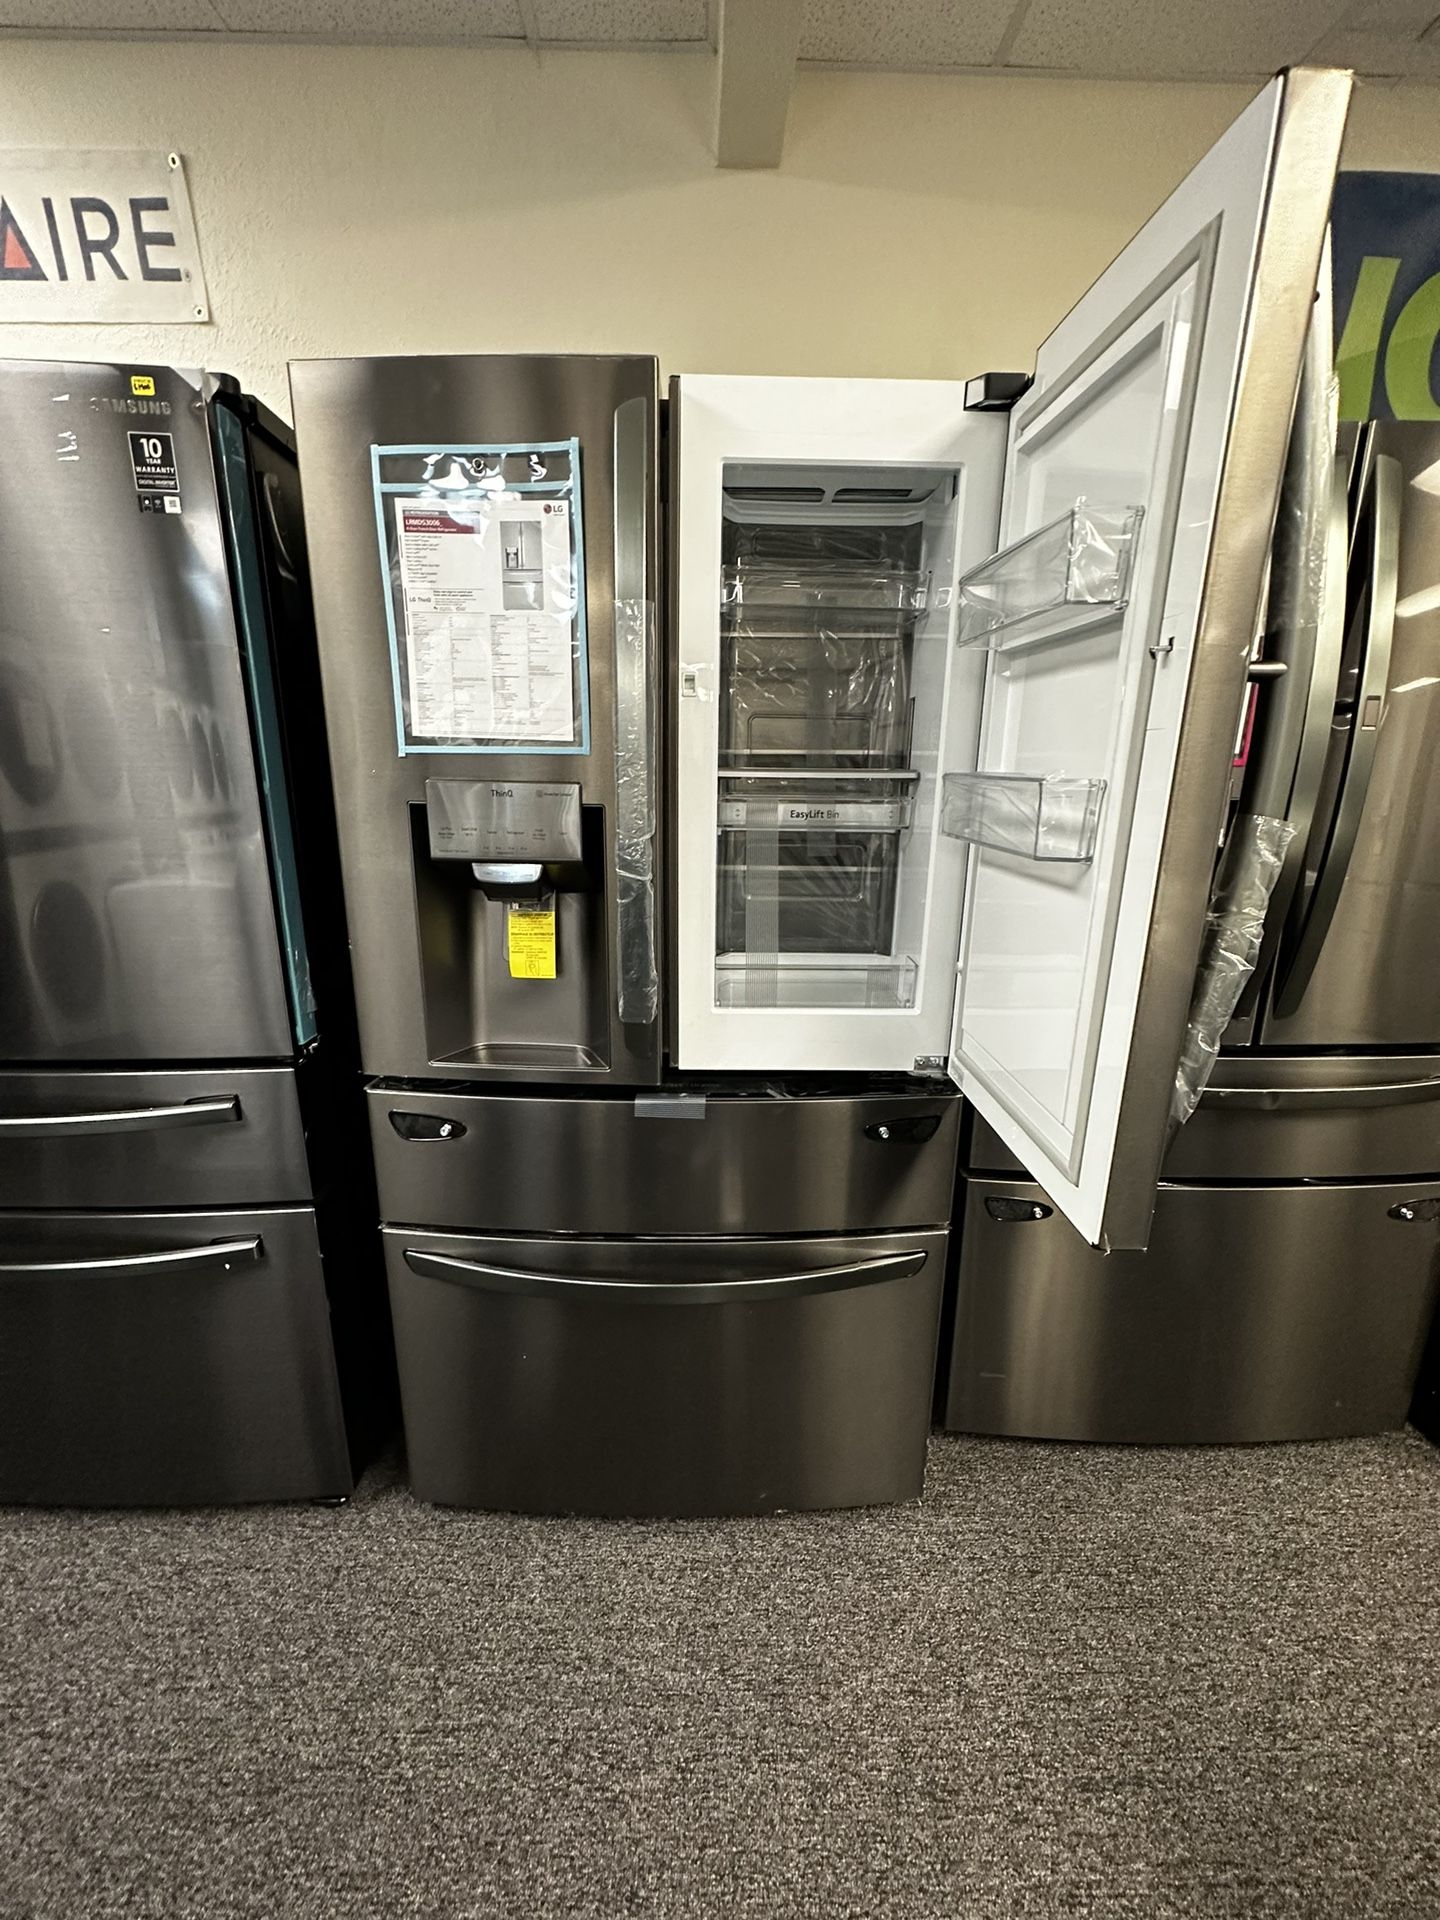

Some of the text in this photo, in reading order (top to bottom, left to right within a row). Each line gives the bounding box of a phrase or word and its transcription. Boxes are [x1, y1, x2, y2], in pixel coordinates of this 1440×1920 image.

[140, 438, 162, 458] 10
[136, 466, 175, 474] WARRANTY
[553, 505, 563, 513] LG
[491, 789, 513, 798] ThinQ
[790, 809, 840, 821] EasyLift Bin
